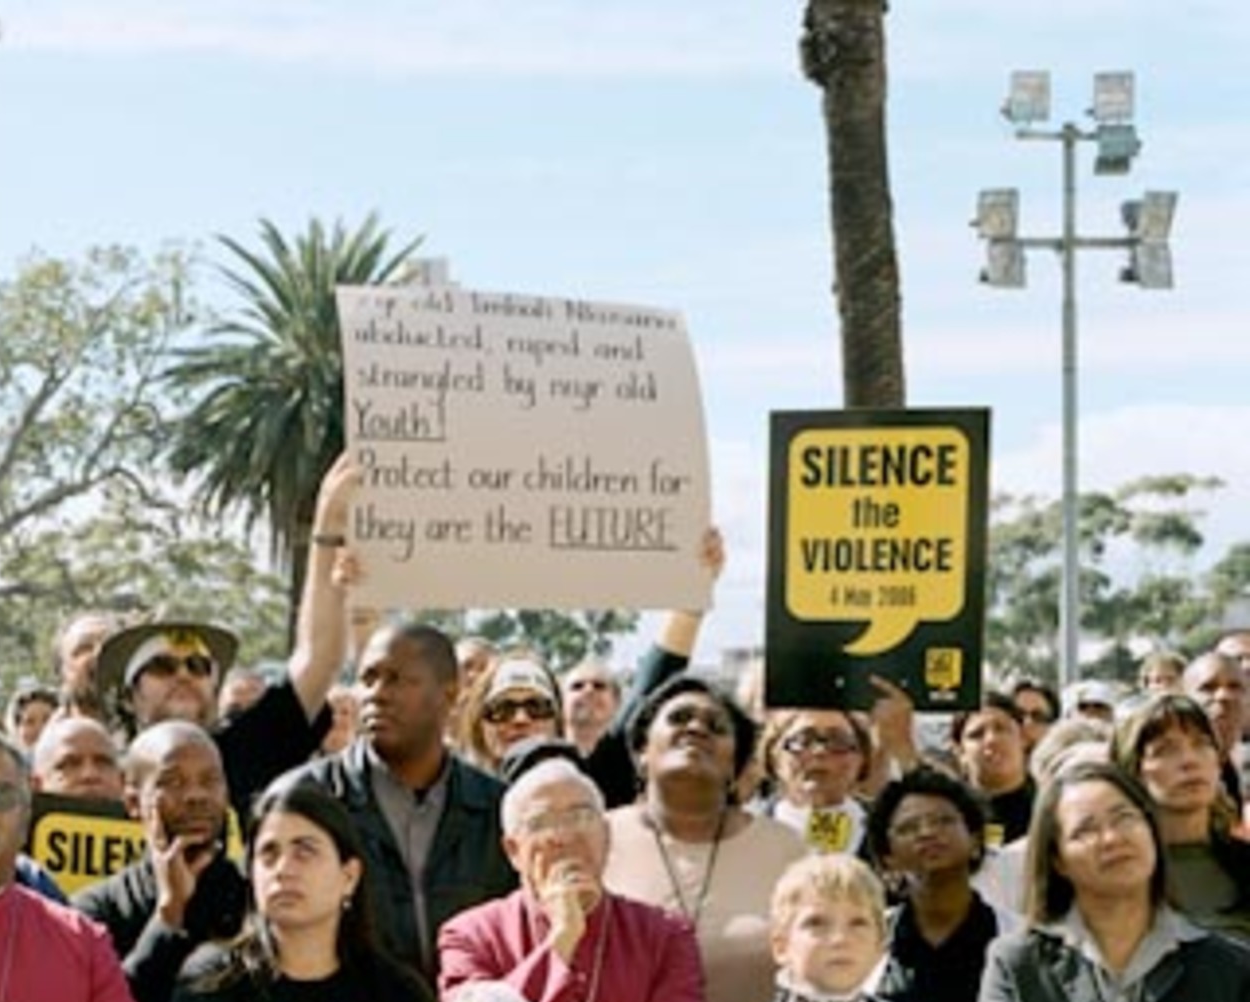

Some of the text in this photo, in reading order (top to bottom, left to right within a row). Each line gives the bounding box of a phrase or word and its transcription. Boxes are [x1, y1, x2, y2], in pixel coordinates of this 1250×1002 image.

[593, 335, 645, 361] and
[503, 364, 536, 409] by
[357, 448, 691, 496] Protect our children for
[801, 444, 958, 488] SILENCE
[353, 502, 675, 563] they are the FUTURE
[851, 496, 901, 529] the
[800, 538, 953, 573] VIOLENCE
[46, 831, 147, 876] SILEN
